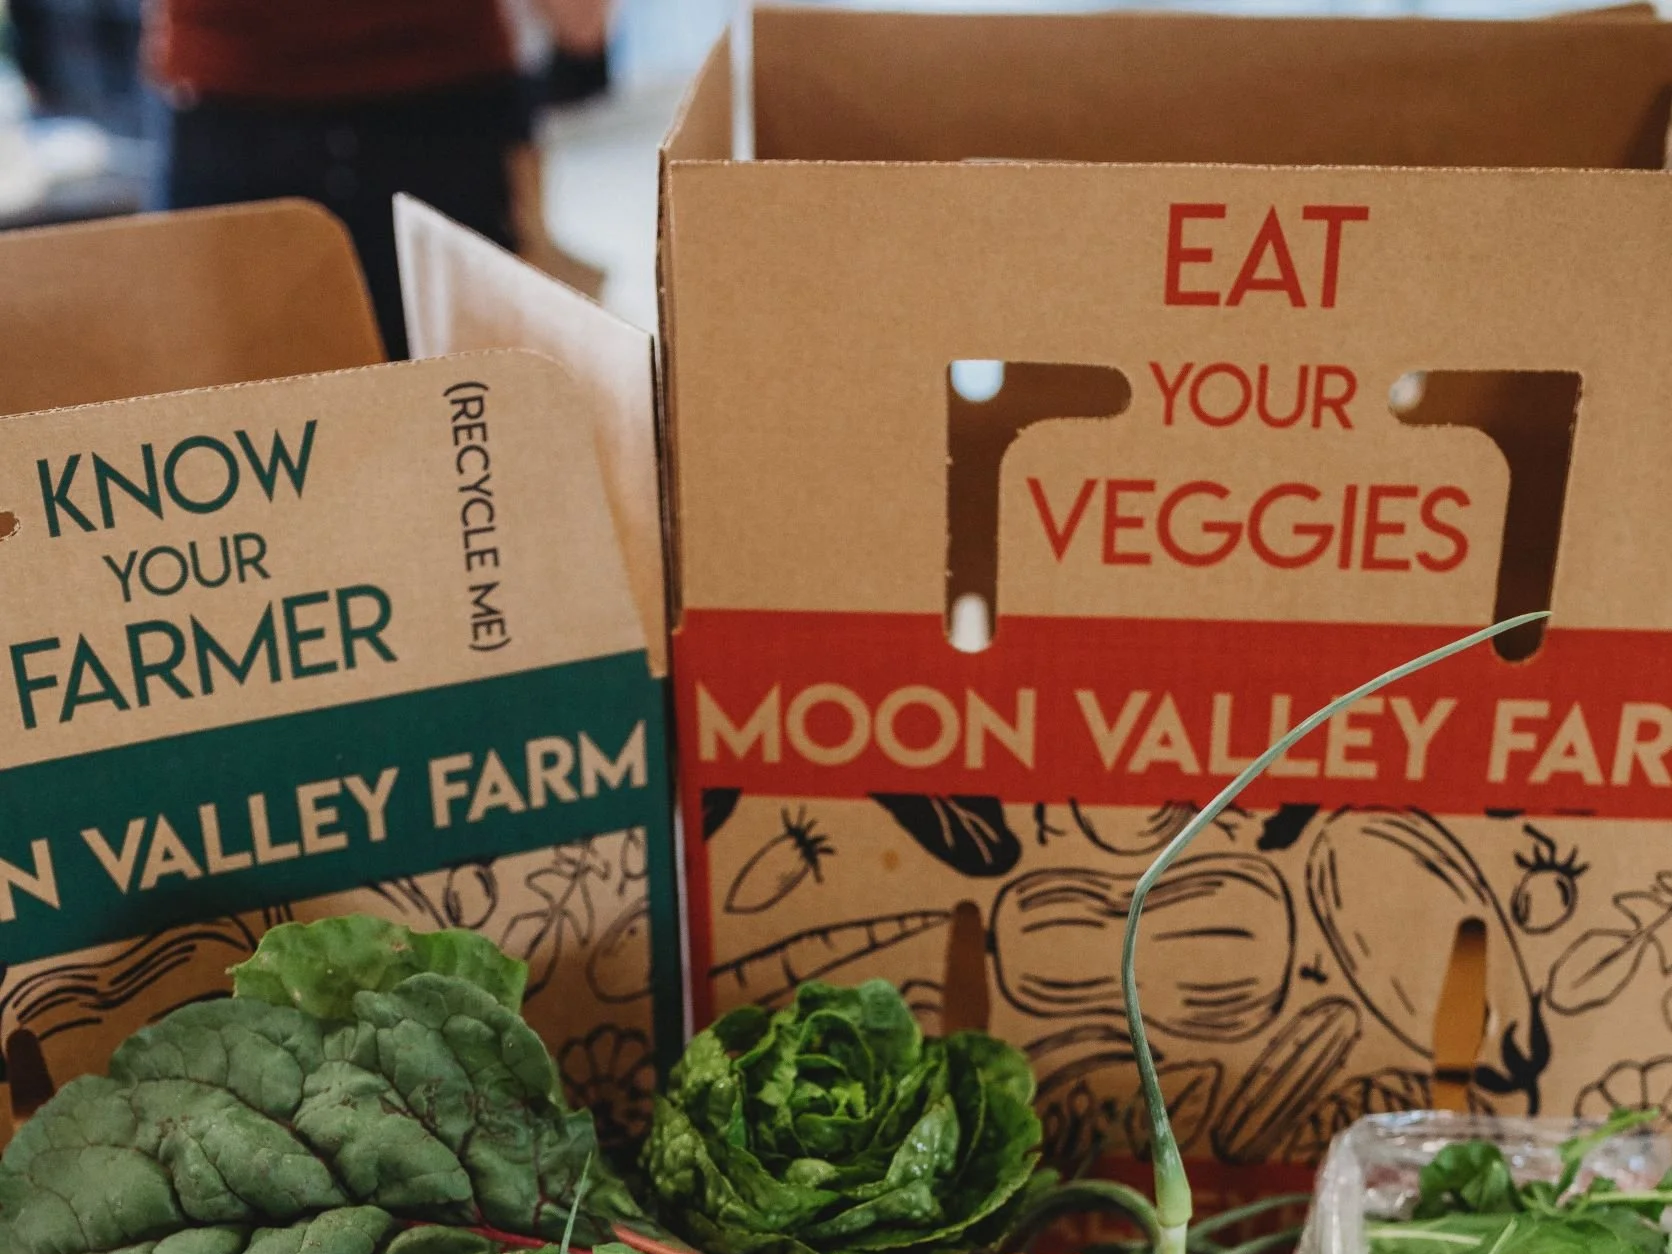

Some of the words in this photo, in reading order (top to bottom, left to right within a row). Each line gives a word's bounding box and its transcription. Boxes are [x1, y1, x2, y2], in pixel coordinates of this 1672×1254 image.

[1163, 202, 1370, 309] EAT
[1149, 361, 1358, 430] YOUR
[36, 419, 318, 538] KNOW
[443, 381, 500, 572] (RECYCLE
[1026, 477, 1471, 573] VEGGIES
[101, 532, 271, 602] YOUR
[468, 581, 512, 652] ME)
[8, 584, 398, 730] FARMER
[696, 682, 1037, 770] MOON
[1074, 688, 1459, 781] VALLEY
[80, 767, 399, 895] VALLEY
[428, 719, 648, 829] FARM
